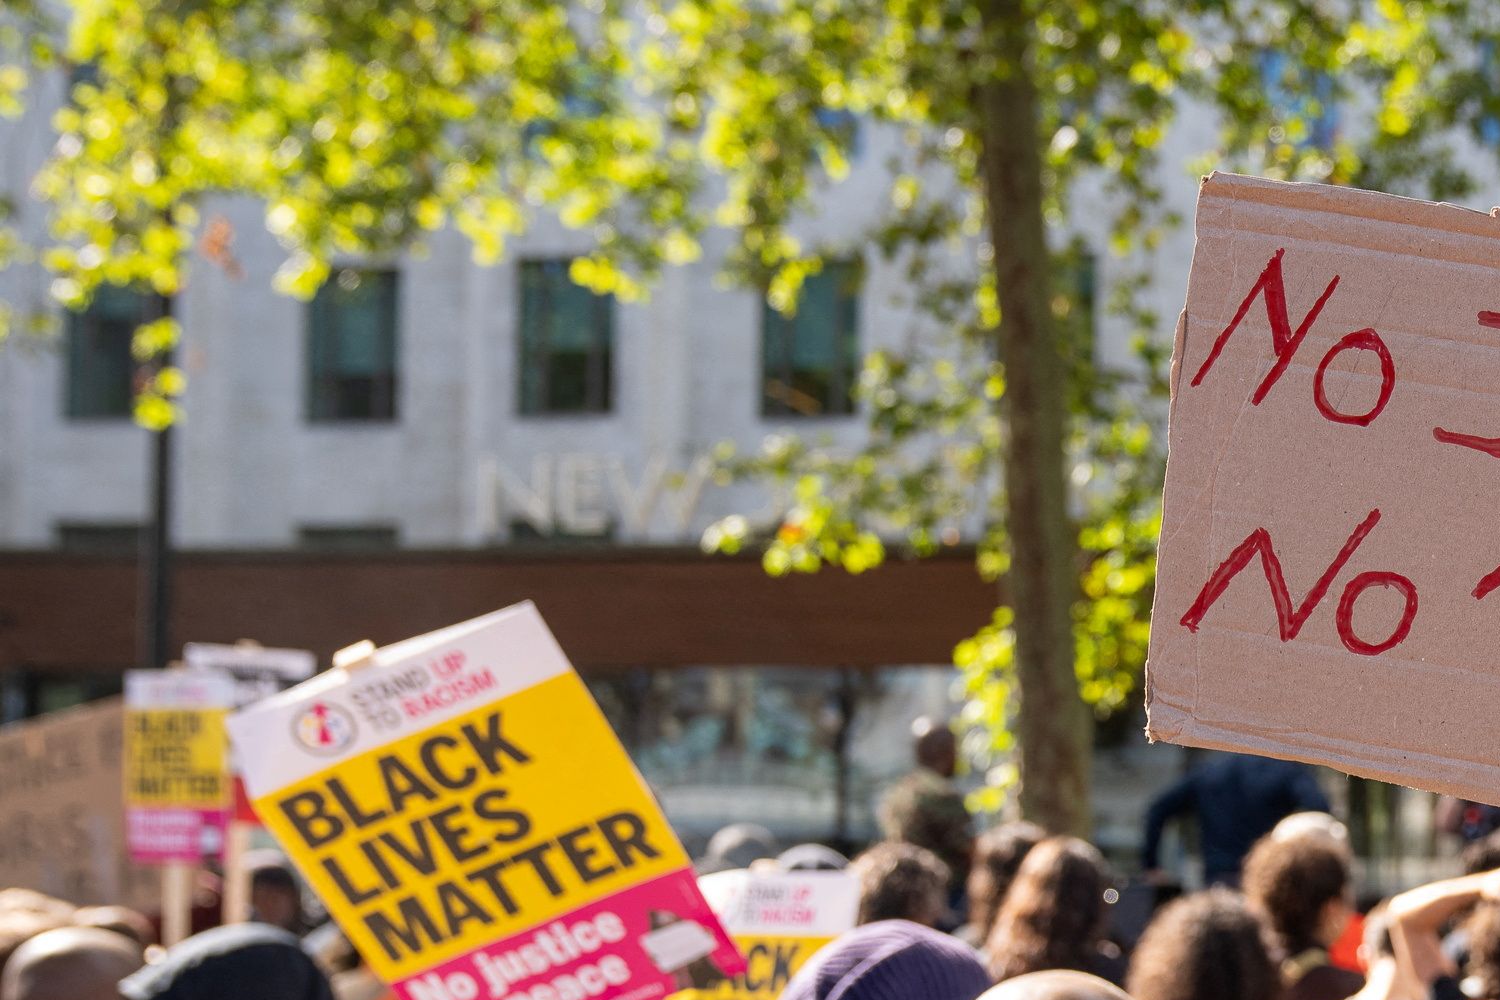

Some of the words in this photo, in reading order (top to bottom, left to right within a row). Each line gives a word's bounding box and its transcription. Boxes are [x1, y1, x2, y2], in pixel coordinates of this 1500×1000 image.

[468, 452, 714, 546] NEW
[351, 666, 432, 708] STAND
[430, 650, 467, 682] UP
[364, 708, 402, 733] TO
[401, 666, 499, 719] RACISM
[278, 711, 533, 850] BLACK
[321, 788, 534, 907] LIVES
[361, 810, 662, 962] MATTER
[473, 911, 627, 998] justice
